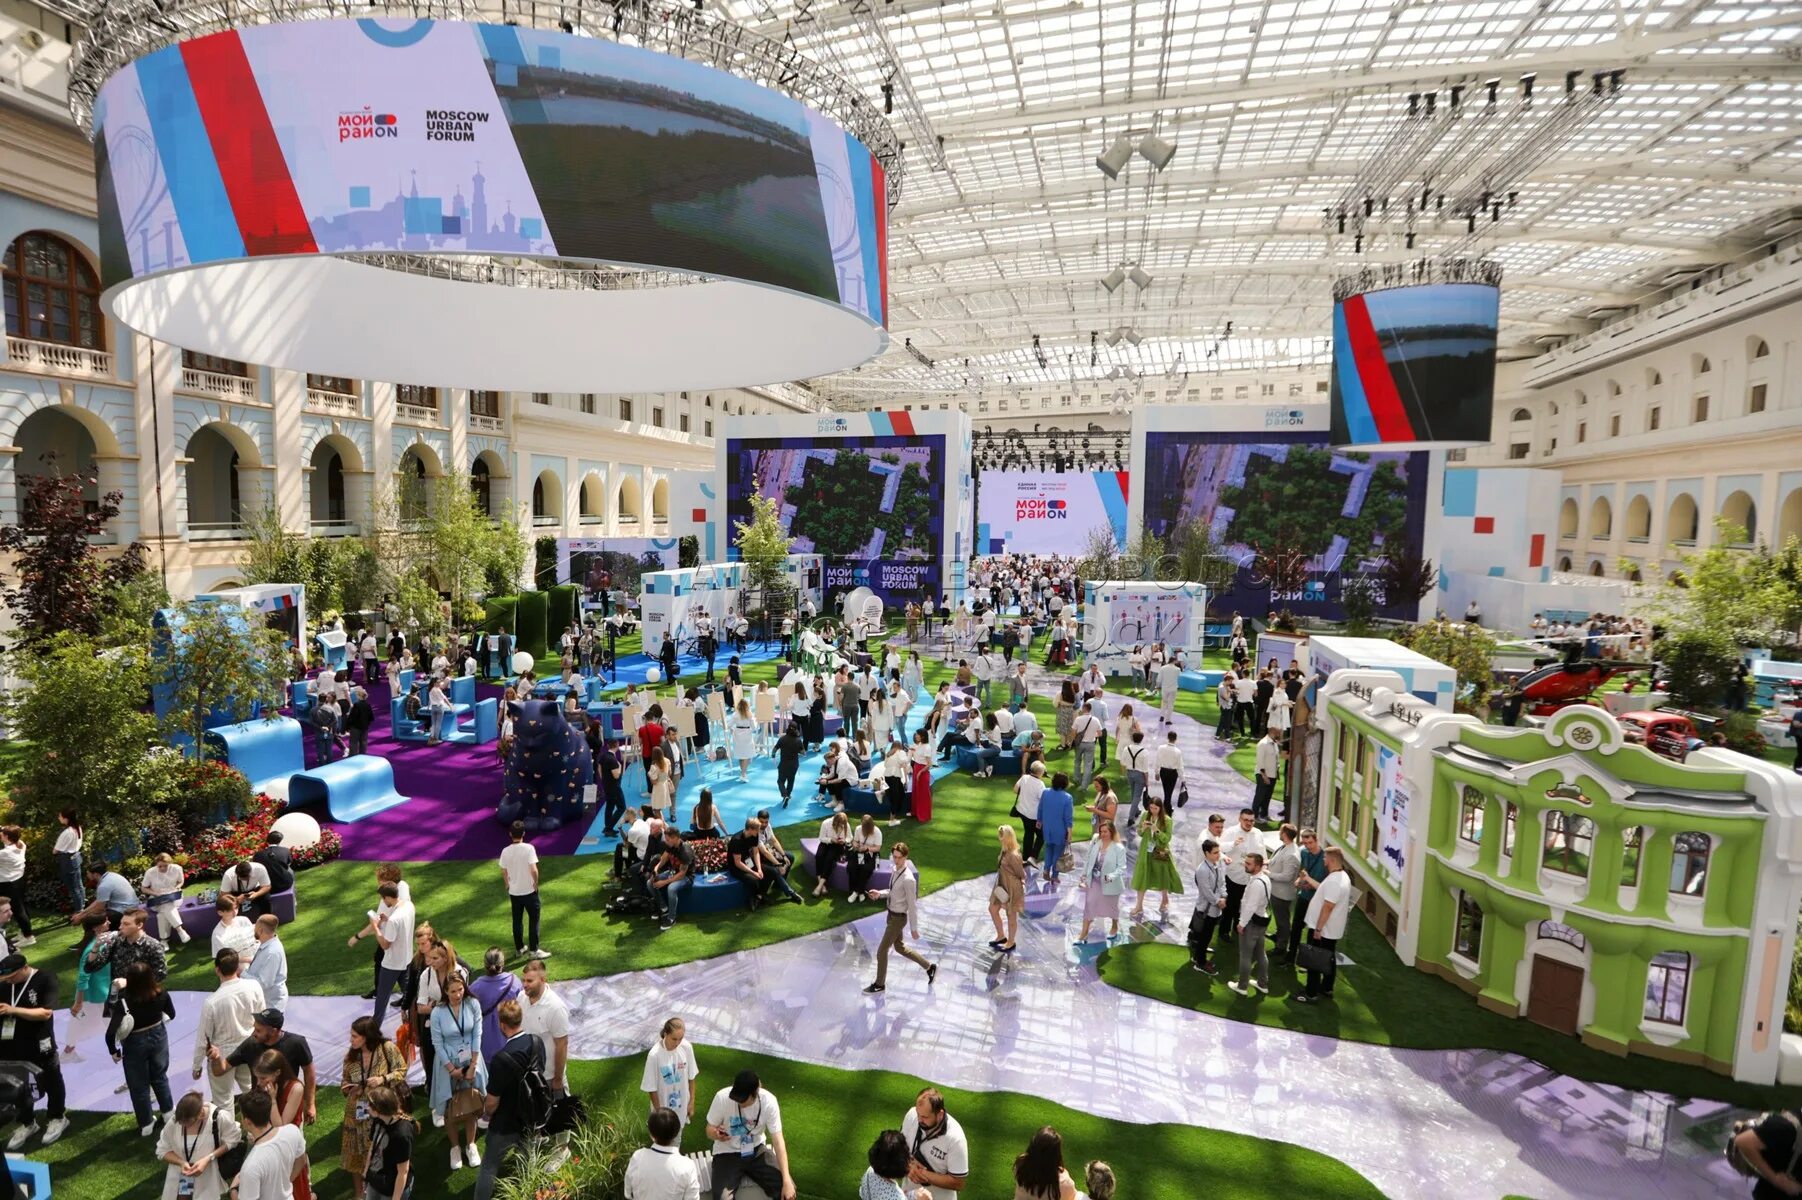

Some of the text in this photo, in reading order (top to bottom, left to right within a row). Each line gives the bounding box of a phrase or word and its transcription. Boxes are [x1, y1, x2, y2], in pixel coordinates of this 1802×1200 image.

[426, 110, 489, 122] MOSCOW
[426, 120, 473, 131] URBAN
[427, 130, 475, 142] FORUM
[882, 565, 929, 575] MOSCOW
[882, 573, 917, 582] URBAN
[882, 580, 918, 589] FORUM
